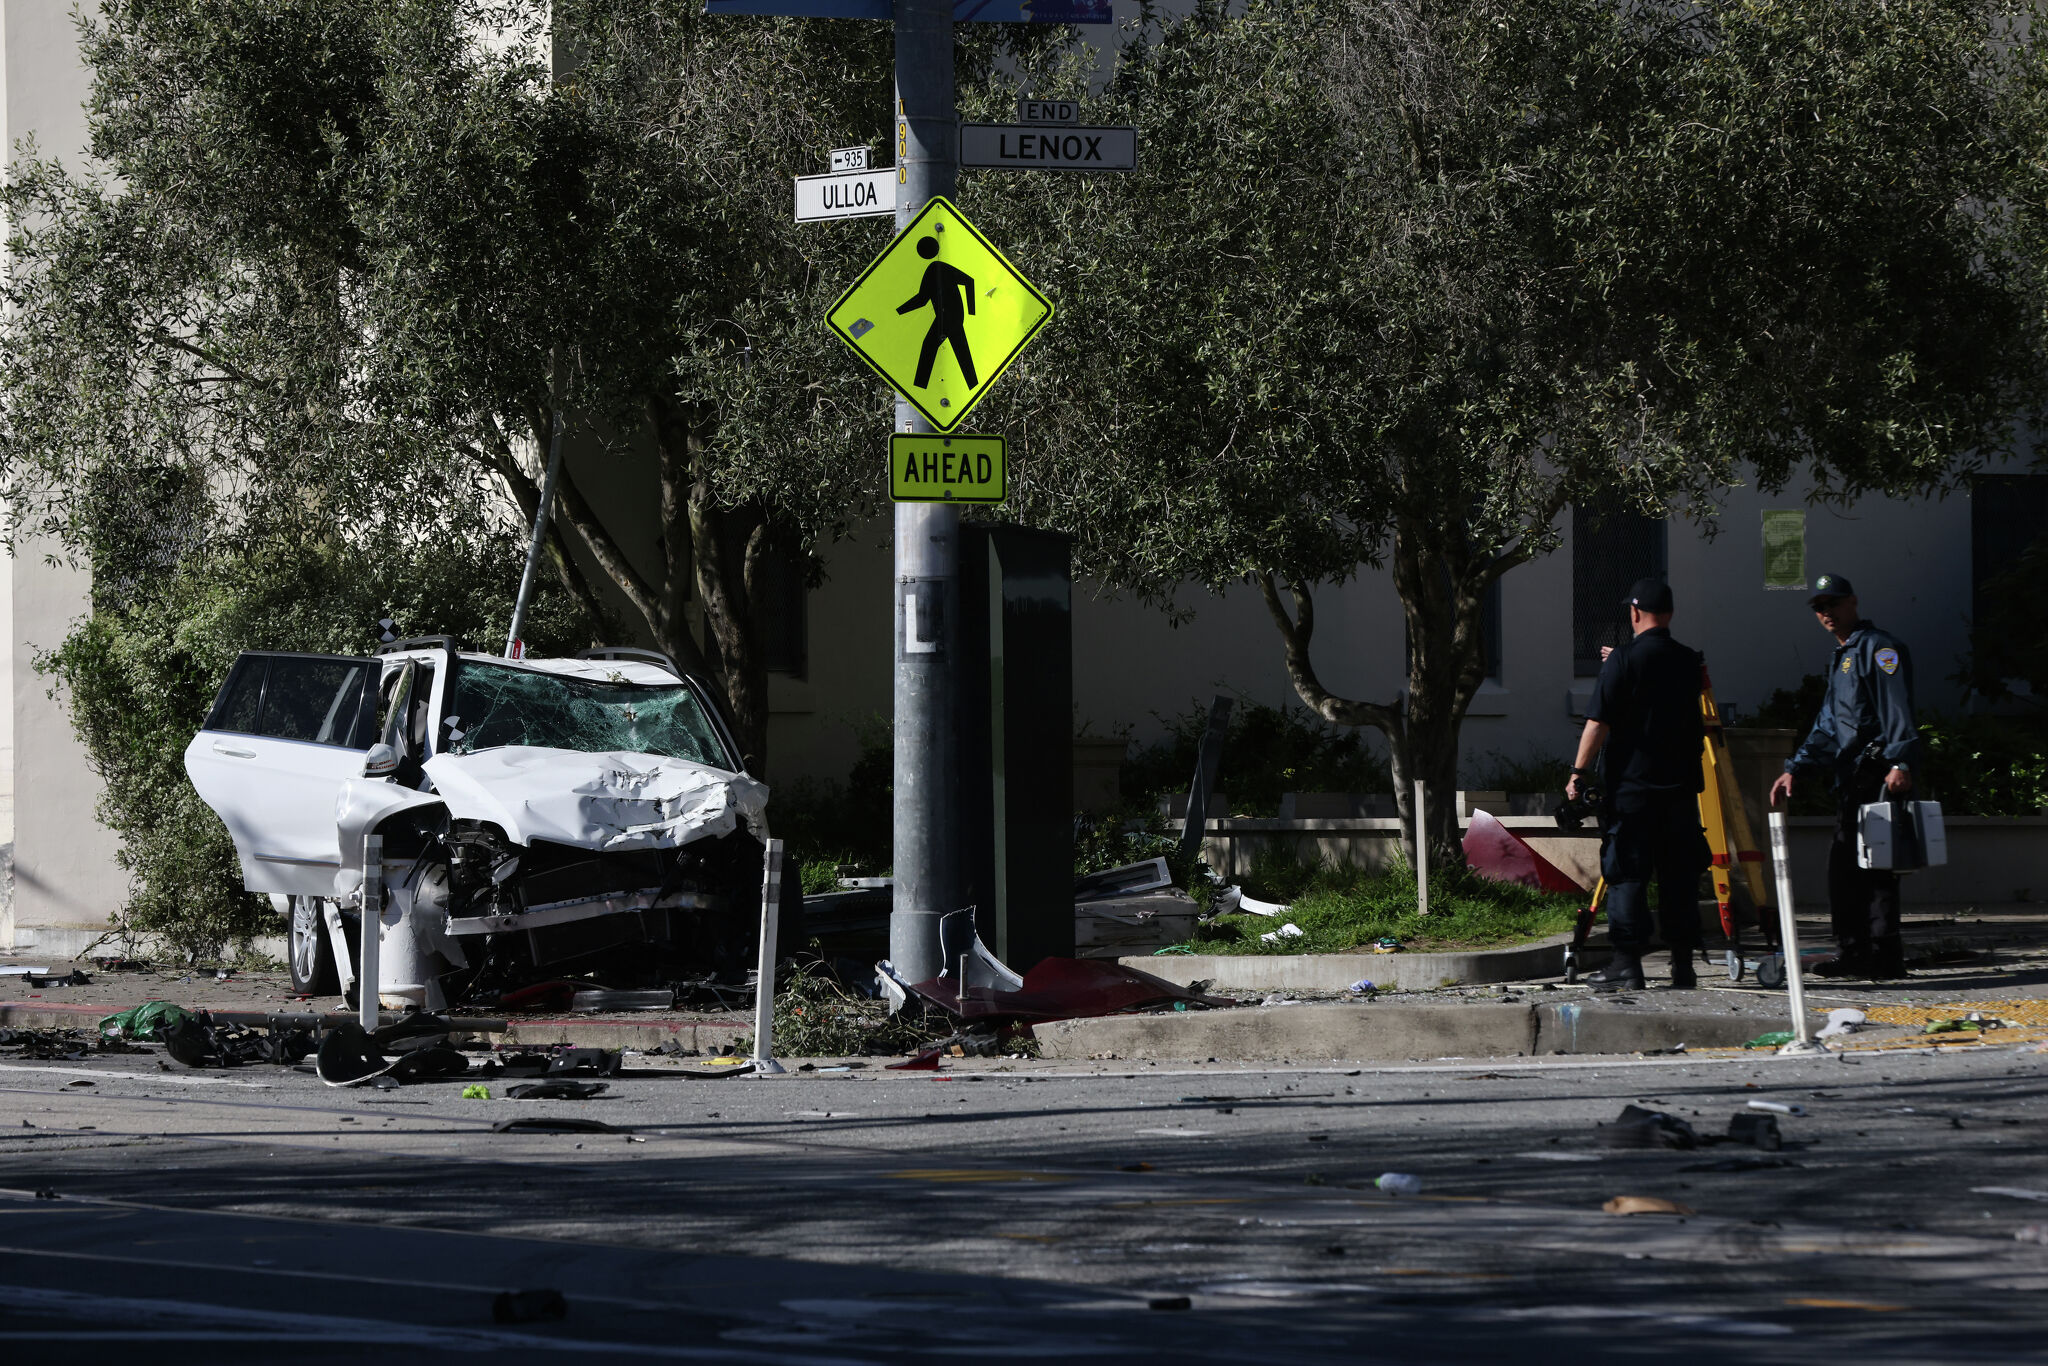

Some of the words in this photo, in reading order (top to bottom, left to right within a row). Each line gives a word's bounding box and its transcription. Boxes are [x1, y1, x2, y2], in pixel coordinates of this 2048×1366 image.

[1027, 104, 1072, 120] END
[844, 151, 863, 168] 935
[1000, 134, 1103, 161] LENOX
[822, 181, 878, 209] ULLOA
[904, 452, 992, 483] AHEAD
